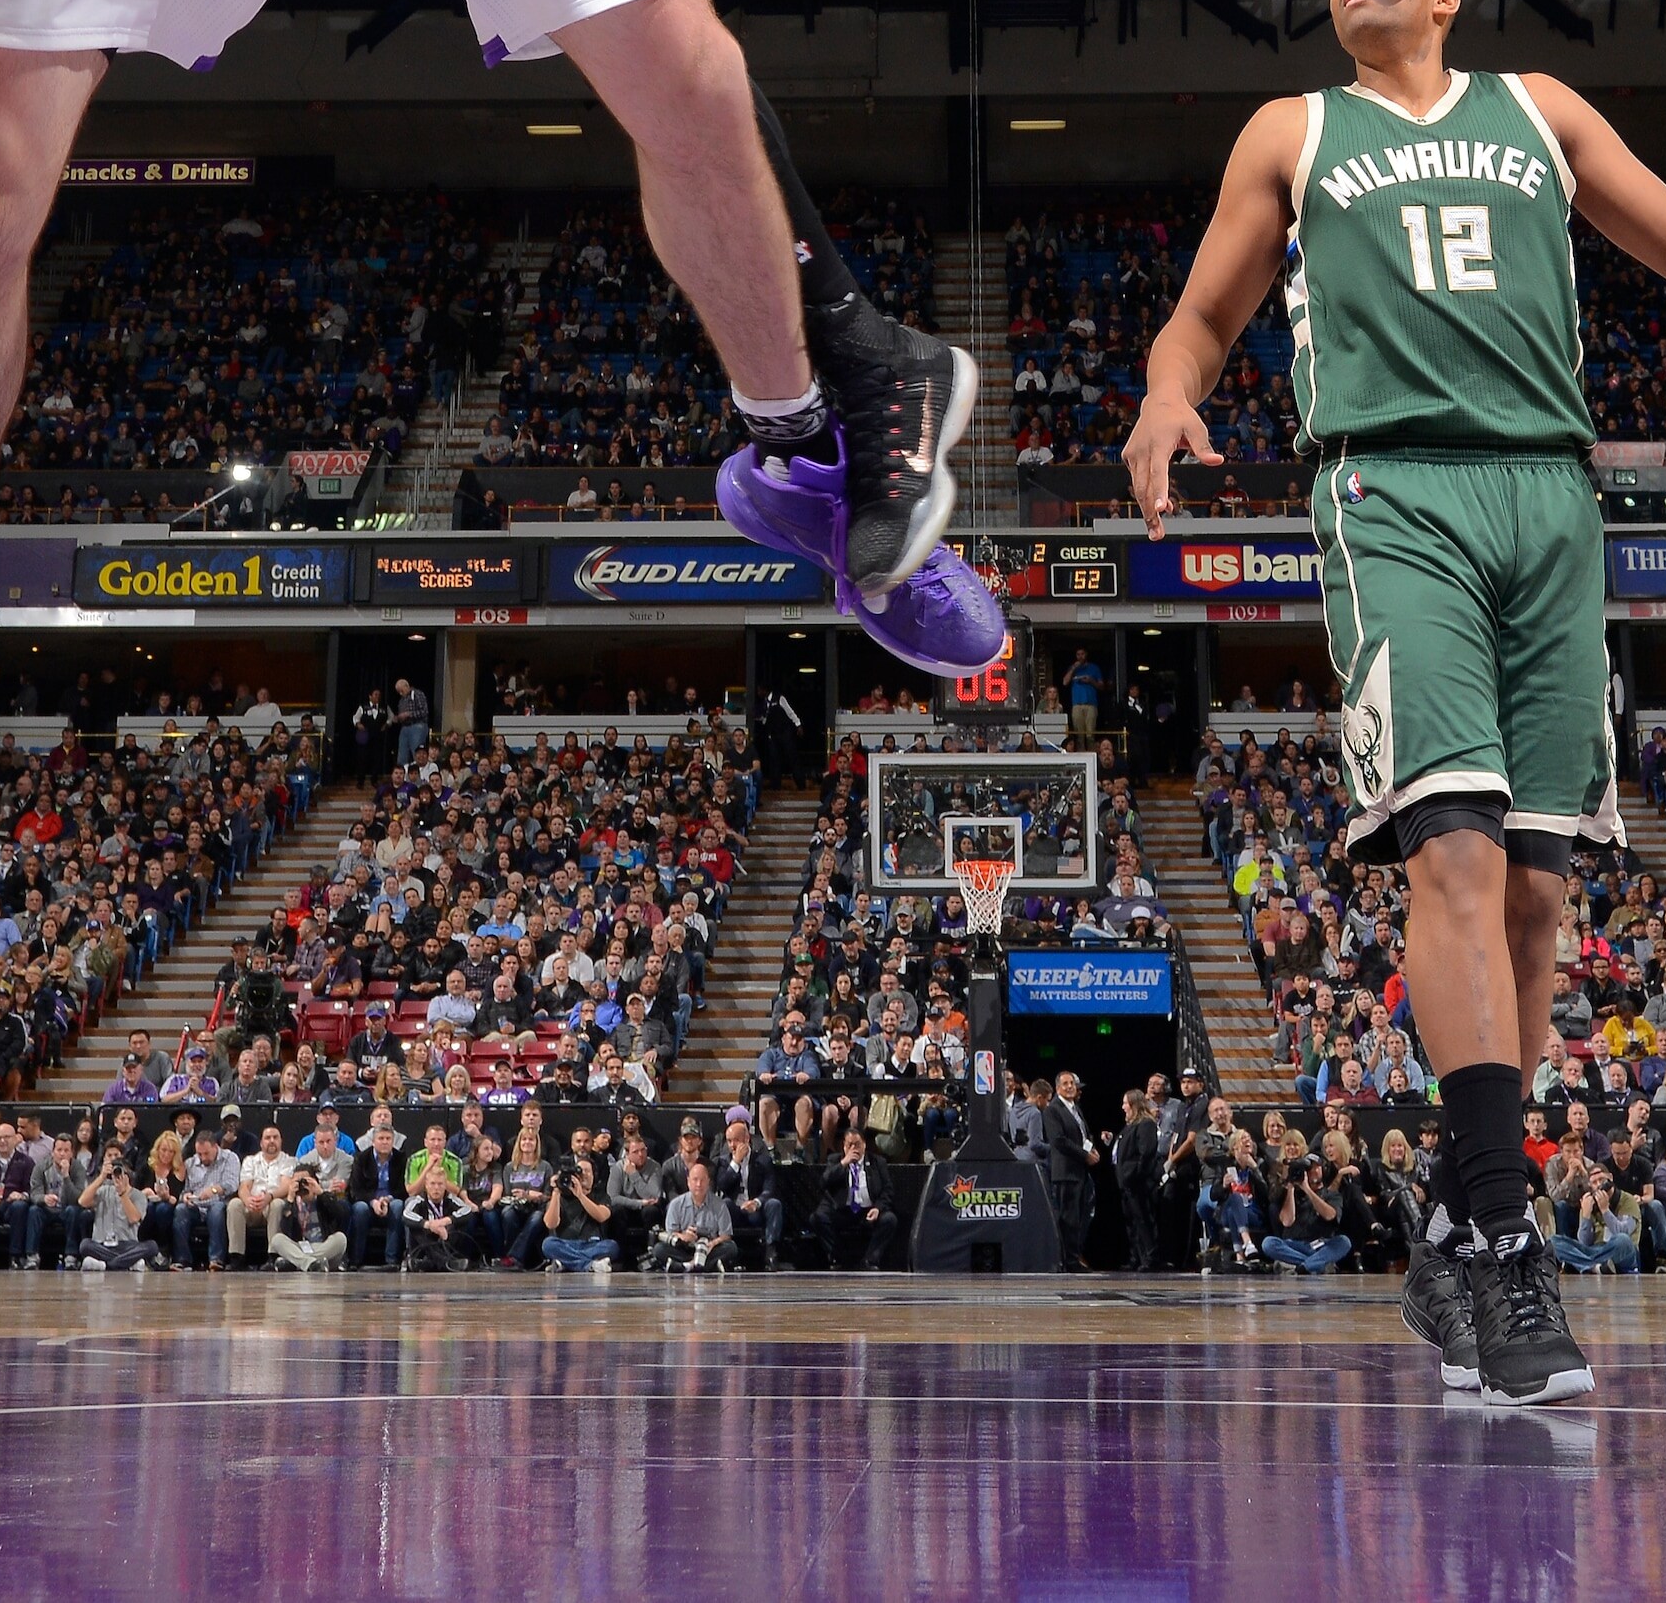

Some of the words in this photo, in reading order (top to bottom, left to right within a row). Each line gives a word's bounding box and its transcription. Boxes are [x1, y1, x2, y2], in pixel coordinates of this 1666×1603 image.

[144, 163, 164, 181] &
[172, 163, 249, 181] Drinks
[1319, 139, 1549, 209] MILWAUKEE
[1400, 203, 1497, 292] 12
[291, 454, 330, 475] 207
[330, 453, 371, 475] 208
[1033, 543, 1047, 563] 2
[1060, 546, 1108, 561] GUEST
[271, 563, 322, 580] Credit
[591, 560, 677, 583] BUD
[677, 560, 796, 583] LIGHT
[1074, 569, 1101, 590] 52
[419, 574, 473, 589] SCORES
[271, 582, 320, 599] Union
[76, 611, 102, 622] Suite
[107, 612, 116, 622] C
[472, 608, 510, 624] 108
[629, 610, 653, 621] Suite
[656, 611, 665, 621] D
[1227, 605, 1258, 621] 109
[1012, 968, 1080, 986] SLEEP
[1093, 968, 1162, 986] TRAIN
[1029, 990, 1092, 1001] MATTRESS
[1094, 990, 1149, 1001] CENTERS
[953, 1189, 1020, 1208] DRAFT
[960, 1203, 1019, 1218] KINGS
